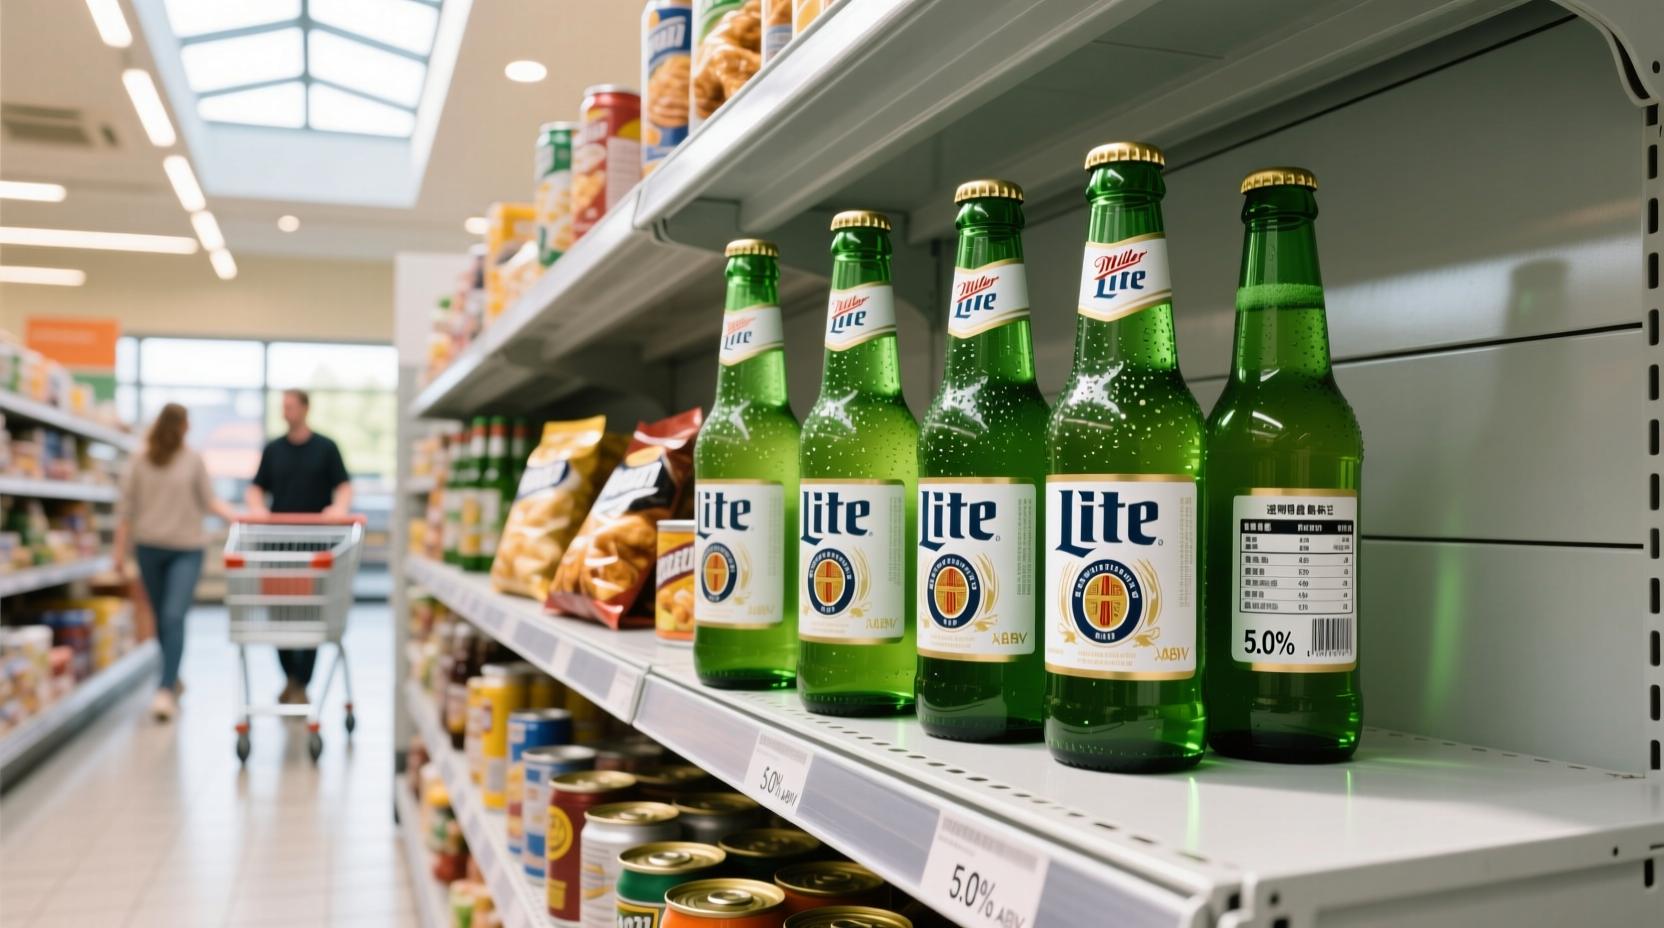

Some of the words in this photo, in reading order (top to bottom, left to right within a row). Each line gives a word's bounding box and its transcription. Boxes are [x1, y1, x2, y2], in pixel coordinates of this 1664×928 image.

[1093, 270, 1146, 299] Lite
[1094, 249, 1147, 278] Miller
[954, 292, 997, 319] Lite
[697, 491, 752, 540] Lite
[800, 490, 871, 546] Lite
[919, 490, 997, 552] Lite
[1055, 489, 1159, 559] Lite
[1244, 629, 1295, 656] 5.0%
[949, 863, 996, 919] 5.0%
